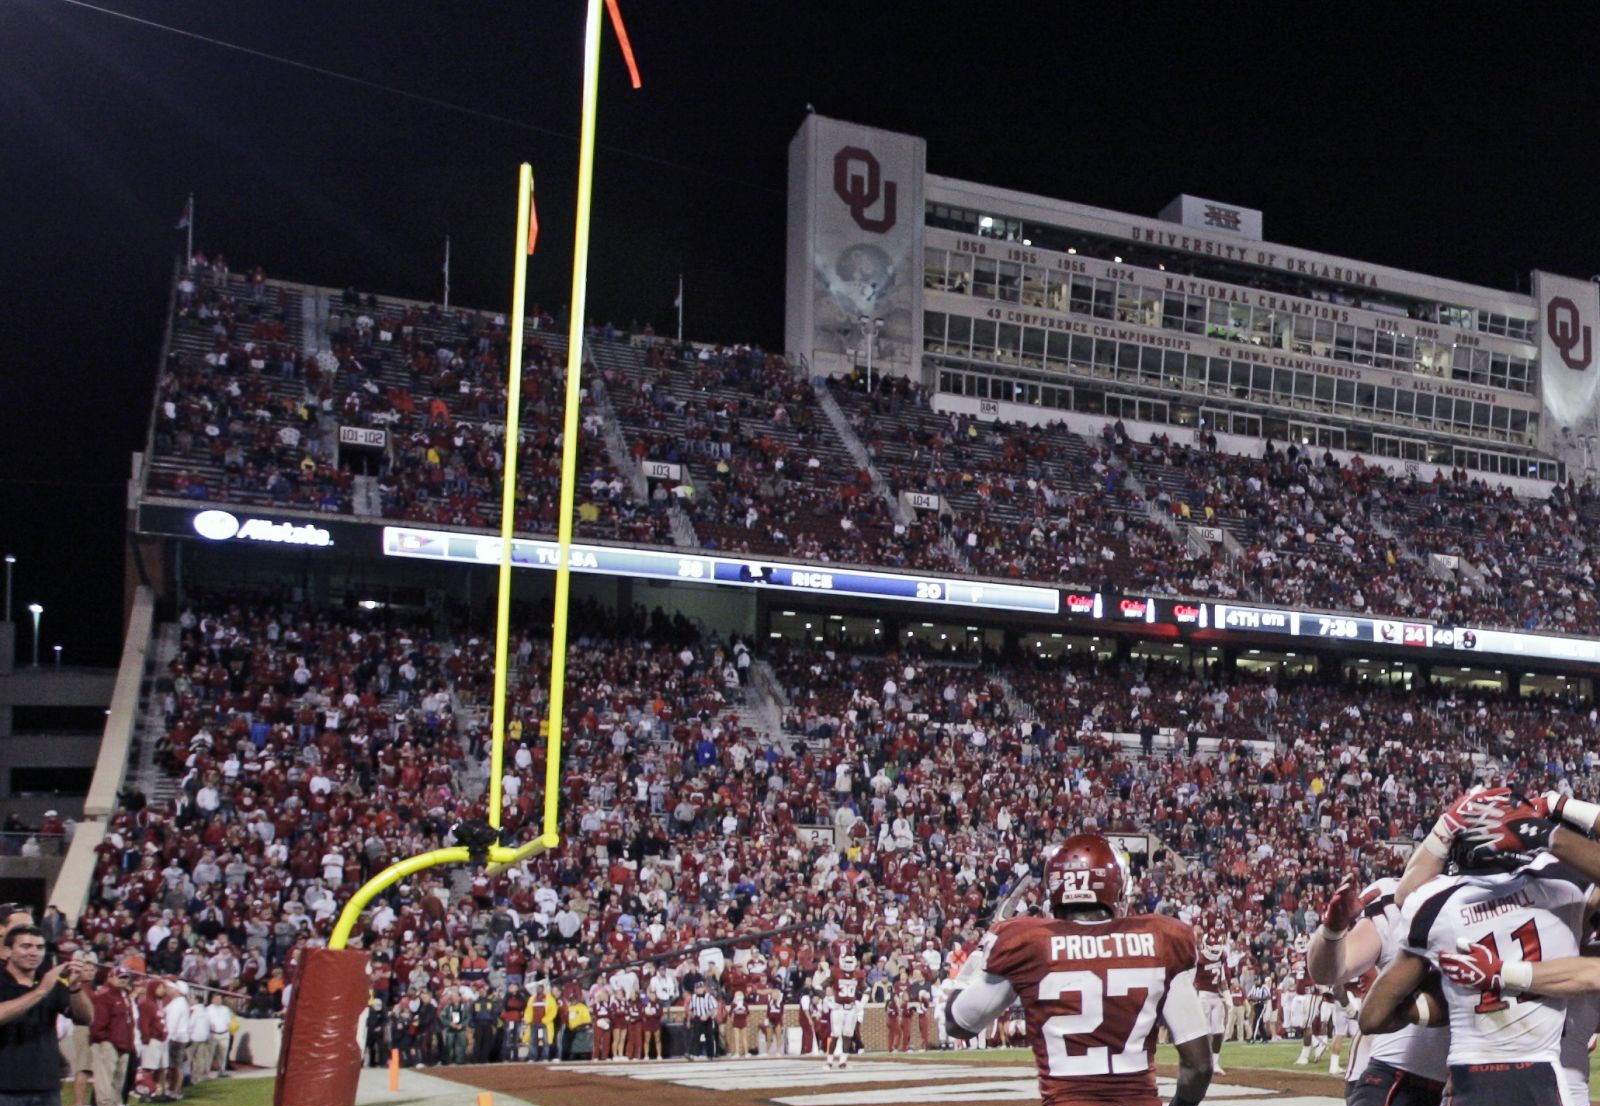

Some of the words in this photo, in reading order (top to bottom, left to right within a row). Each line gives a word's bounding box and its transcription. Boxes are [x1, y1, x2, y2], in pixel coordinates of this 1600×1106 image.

[834, 145, 897, 234] OU
[1132, 226, 1248, 261] UNIVERSITY
[1257, 251, 1277, 266] OF
[1287, 257, 1379, 288] OKLAHOMA
[1105, 267, 1135, 282] 1974
[1165, 277, 1250, 304] NATIONAL
[1259, 295, 1349, 323] CHAMPIONS
[1008, 310, 1088, 334] CONFERENCE
[1093, 325, 1191, 350] CHAMPIONSHIPS
[1547, 296, 1593, 371] OU
[1238, 350, 1268, 363] BOWL
[1272, 355, 1362, 379] CHAMPIONSHIPS
[1413, 381, 1497, 403] ALL-AMERICANS
[982, 402, 997, 413] 104
[342, 429, 383, 444] 101-102
[652, 464, 670, 478] 103
[912, 495, 930, 507] 104
[791, 570, 833, 589] RICE
[916, 582, 942, 599] 20
[1066, 594, 1094, 607] Coke
[1119, 600, 1147, 612] Coke
[1173, 604, 1201, 618] Coke
[1226, 610, 1259, 628] 4TH
[1404, 627, 1425, 643] 24
[1433, 629, 1454, 645] 40
[1063, 870, 1090, 890] 27
[1051, 932, 1156, 961] PROCTOR
[1473, 916, 1543, 1014] 11
[1038, 966, 1167, 1077] 27
